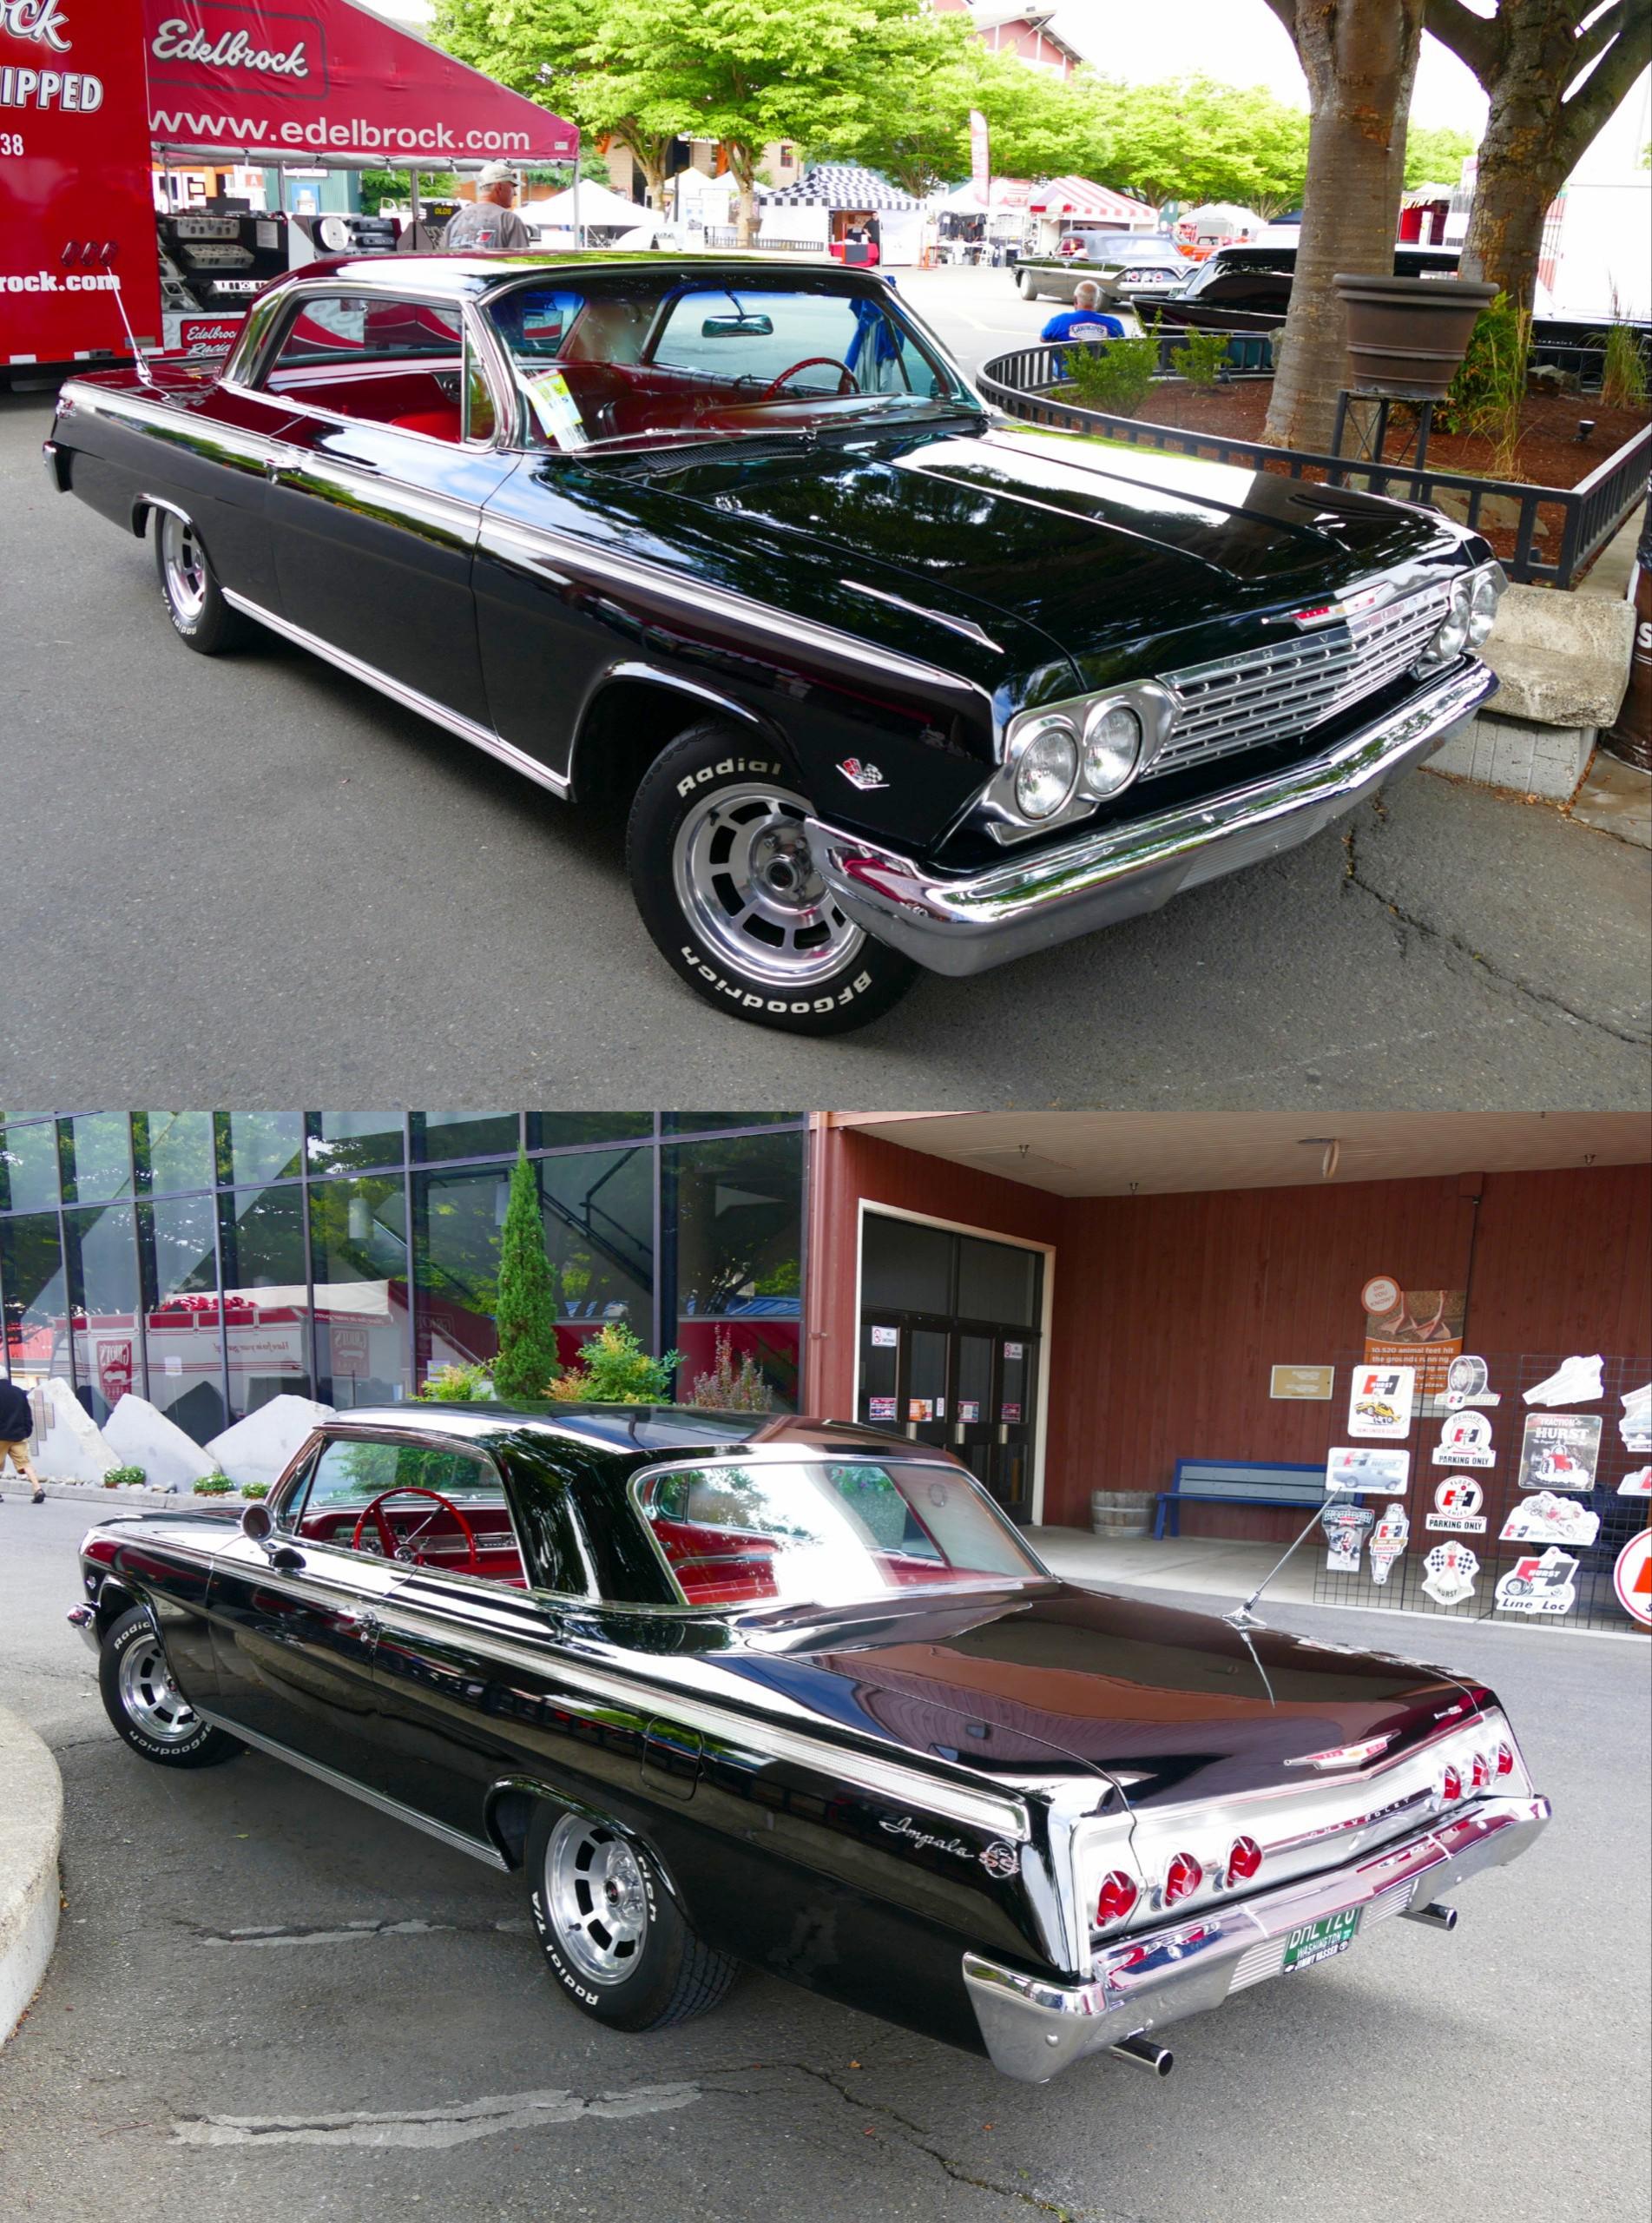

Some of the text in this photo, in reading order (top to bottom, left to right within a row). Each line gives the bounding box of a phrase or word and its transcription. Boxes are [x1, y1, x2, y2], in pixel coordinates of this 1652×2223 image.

[152, 18, 309, 77] Edelbrock
[148, 109, 530, 150] www.edelbrock.com
[187, 325, 237, 340] Edelbroc
[187, 342, 231, 359] Racin
[676, 757, 781, 798] Radial
[681, 946, 872, 1014] BFGoodrich
[1535, 1427, 1589, 1440] HURST
[1438, 1455, 1470, 1464] PARKING
[1429, 1519, 1483, 1530] PARKING ONLY
[1528, 1568, 1561, 1578] HURST
[1502, 1598, 1566, 1611] Line Loc
[879, 1817, 975, 1857] Impala
[1297, 1929, 1342, 1960] WASHINGTON
[545, 1944, 599, 2006] Radial
